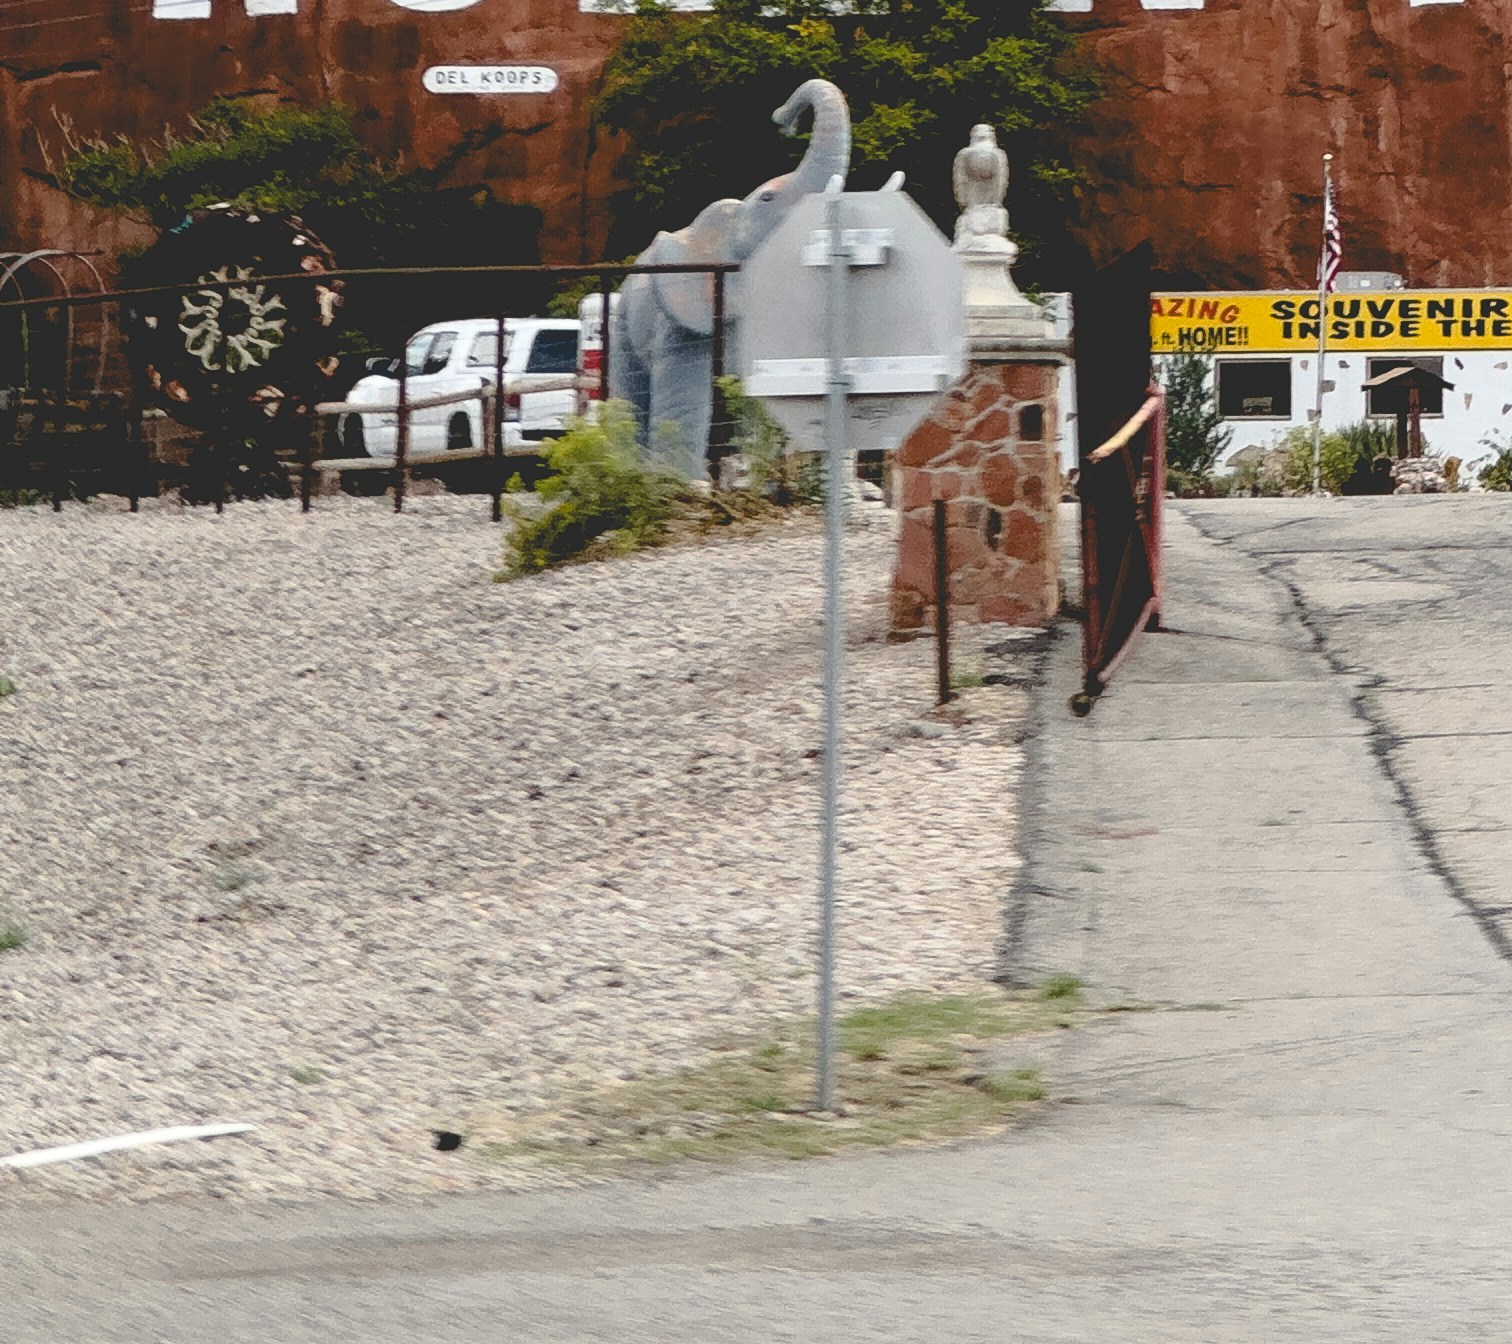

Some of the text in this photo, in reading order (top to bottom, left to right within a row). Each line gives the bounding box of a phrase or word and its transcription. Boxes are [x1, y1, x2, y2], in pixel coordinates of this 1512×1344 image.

[435, 70, 542, 85] DEL KOOPS
[1150, 298, 1240, 324] AZING
[1270, 298, 1509, 320] SOUVENIR
[1178, 326, 1249, 346] HOME!!
[1281, 320, 1422, 339] INSIDE
[1437, 319, 1512, 338] THE
